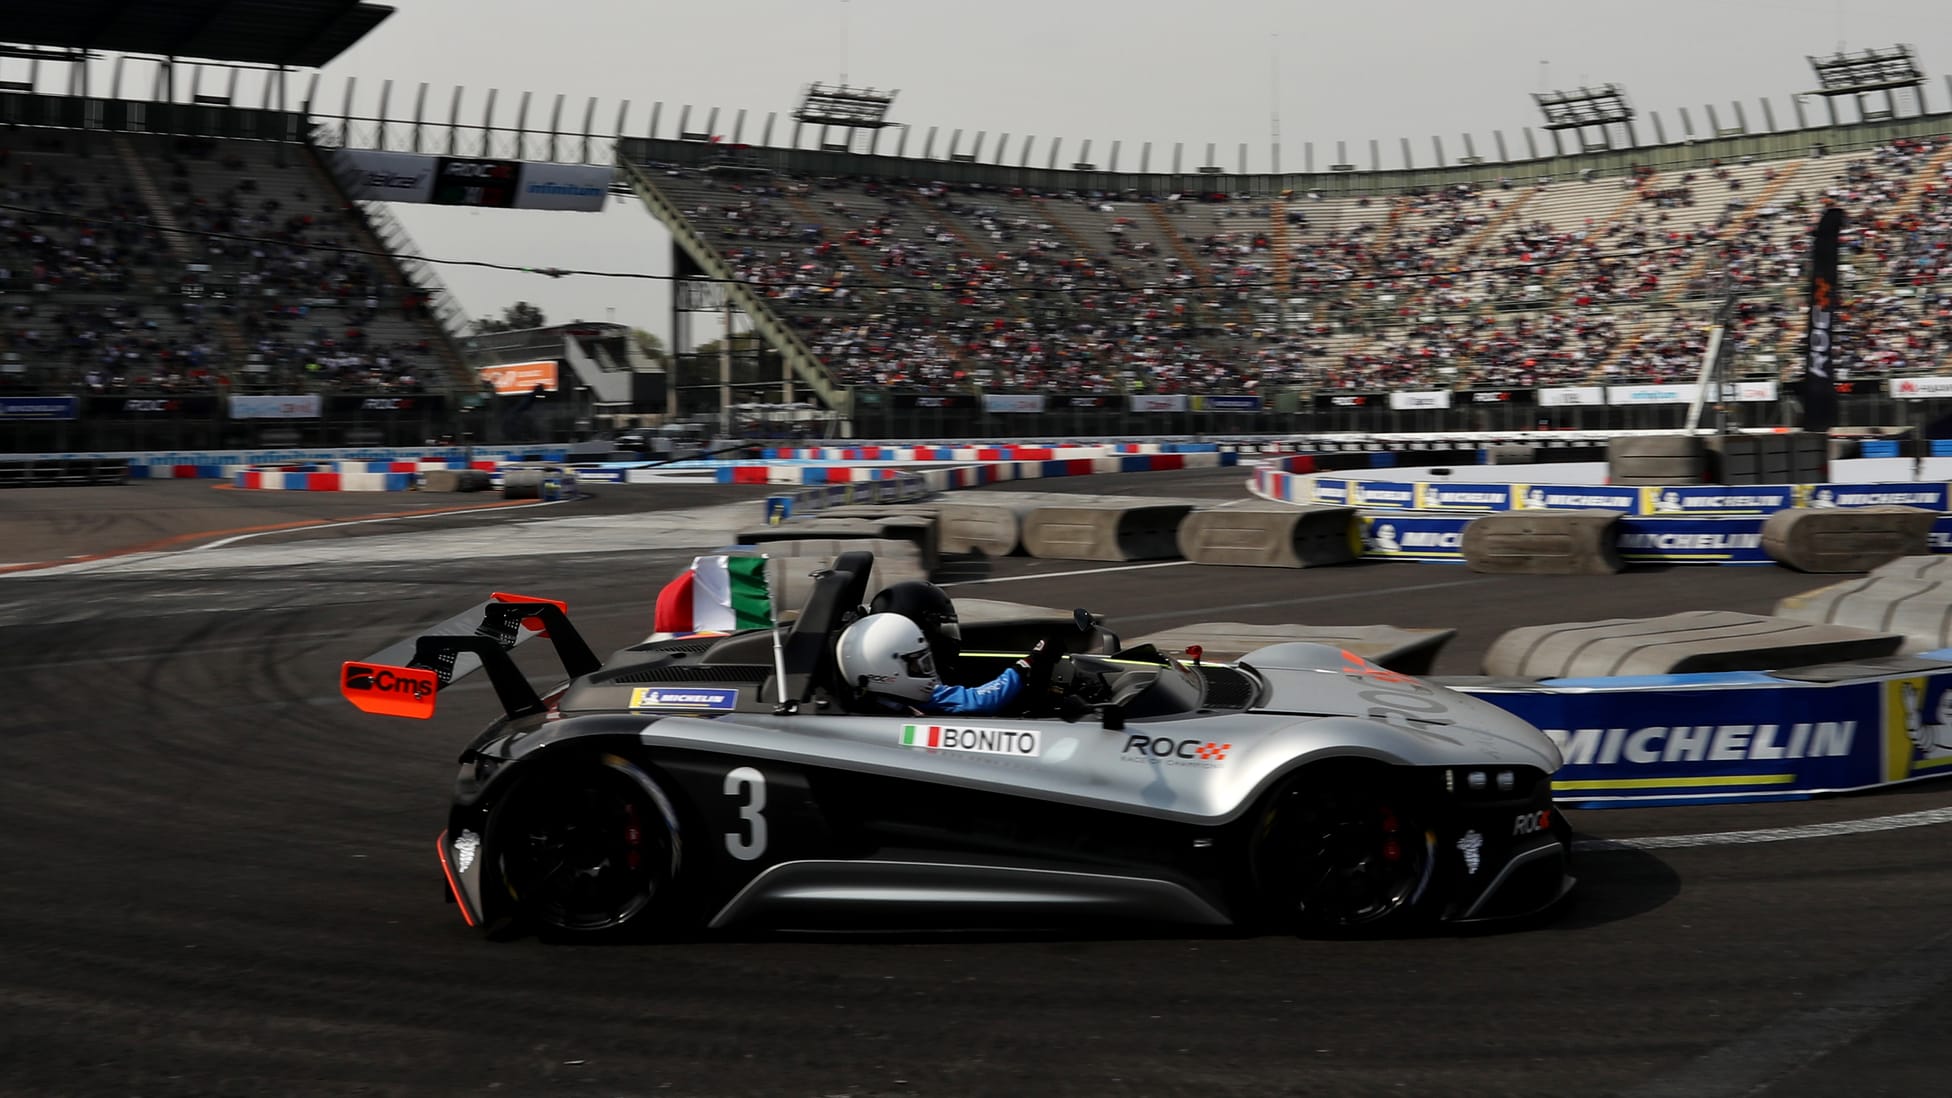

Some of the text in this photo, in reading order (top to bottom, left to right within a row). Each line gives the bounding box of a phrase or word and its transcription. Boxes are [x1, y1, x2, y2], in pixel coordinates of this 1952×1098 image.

[376, 669, 433, 697] Cms
[659, 694, 726, 704] MICHELIN
[942, 728, 1036, 754] BONITO
[1122, 735, 1202, 759] ROC
[1542, 720, 1858, 765] MICHELIN
[723, 766, 768, 861] 3
